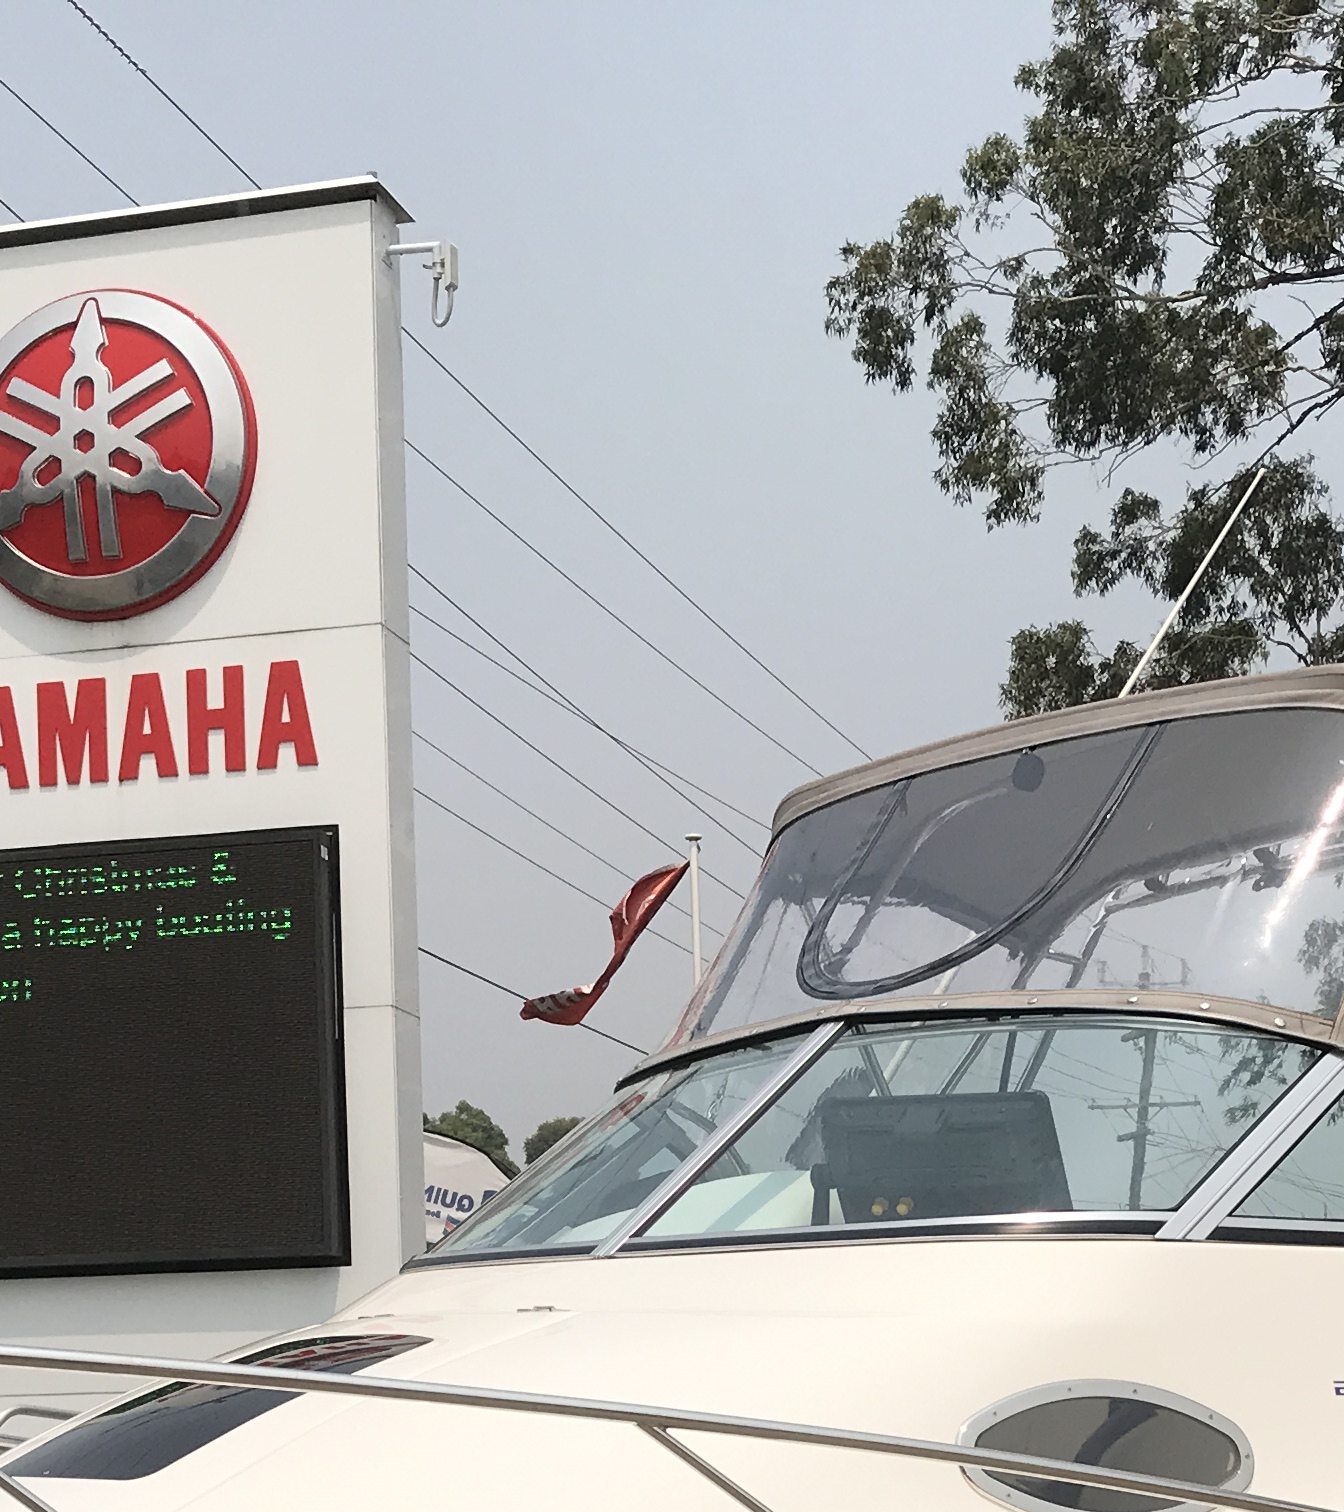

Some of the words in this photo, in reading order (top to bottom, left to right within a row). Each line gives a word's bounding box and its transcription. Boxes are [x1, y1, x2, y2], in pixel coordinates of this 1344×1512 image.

[15, 861, 197, 901] Christmas
[1, 921, 24, 949] a
[33, 915, 144, 951] happy
